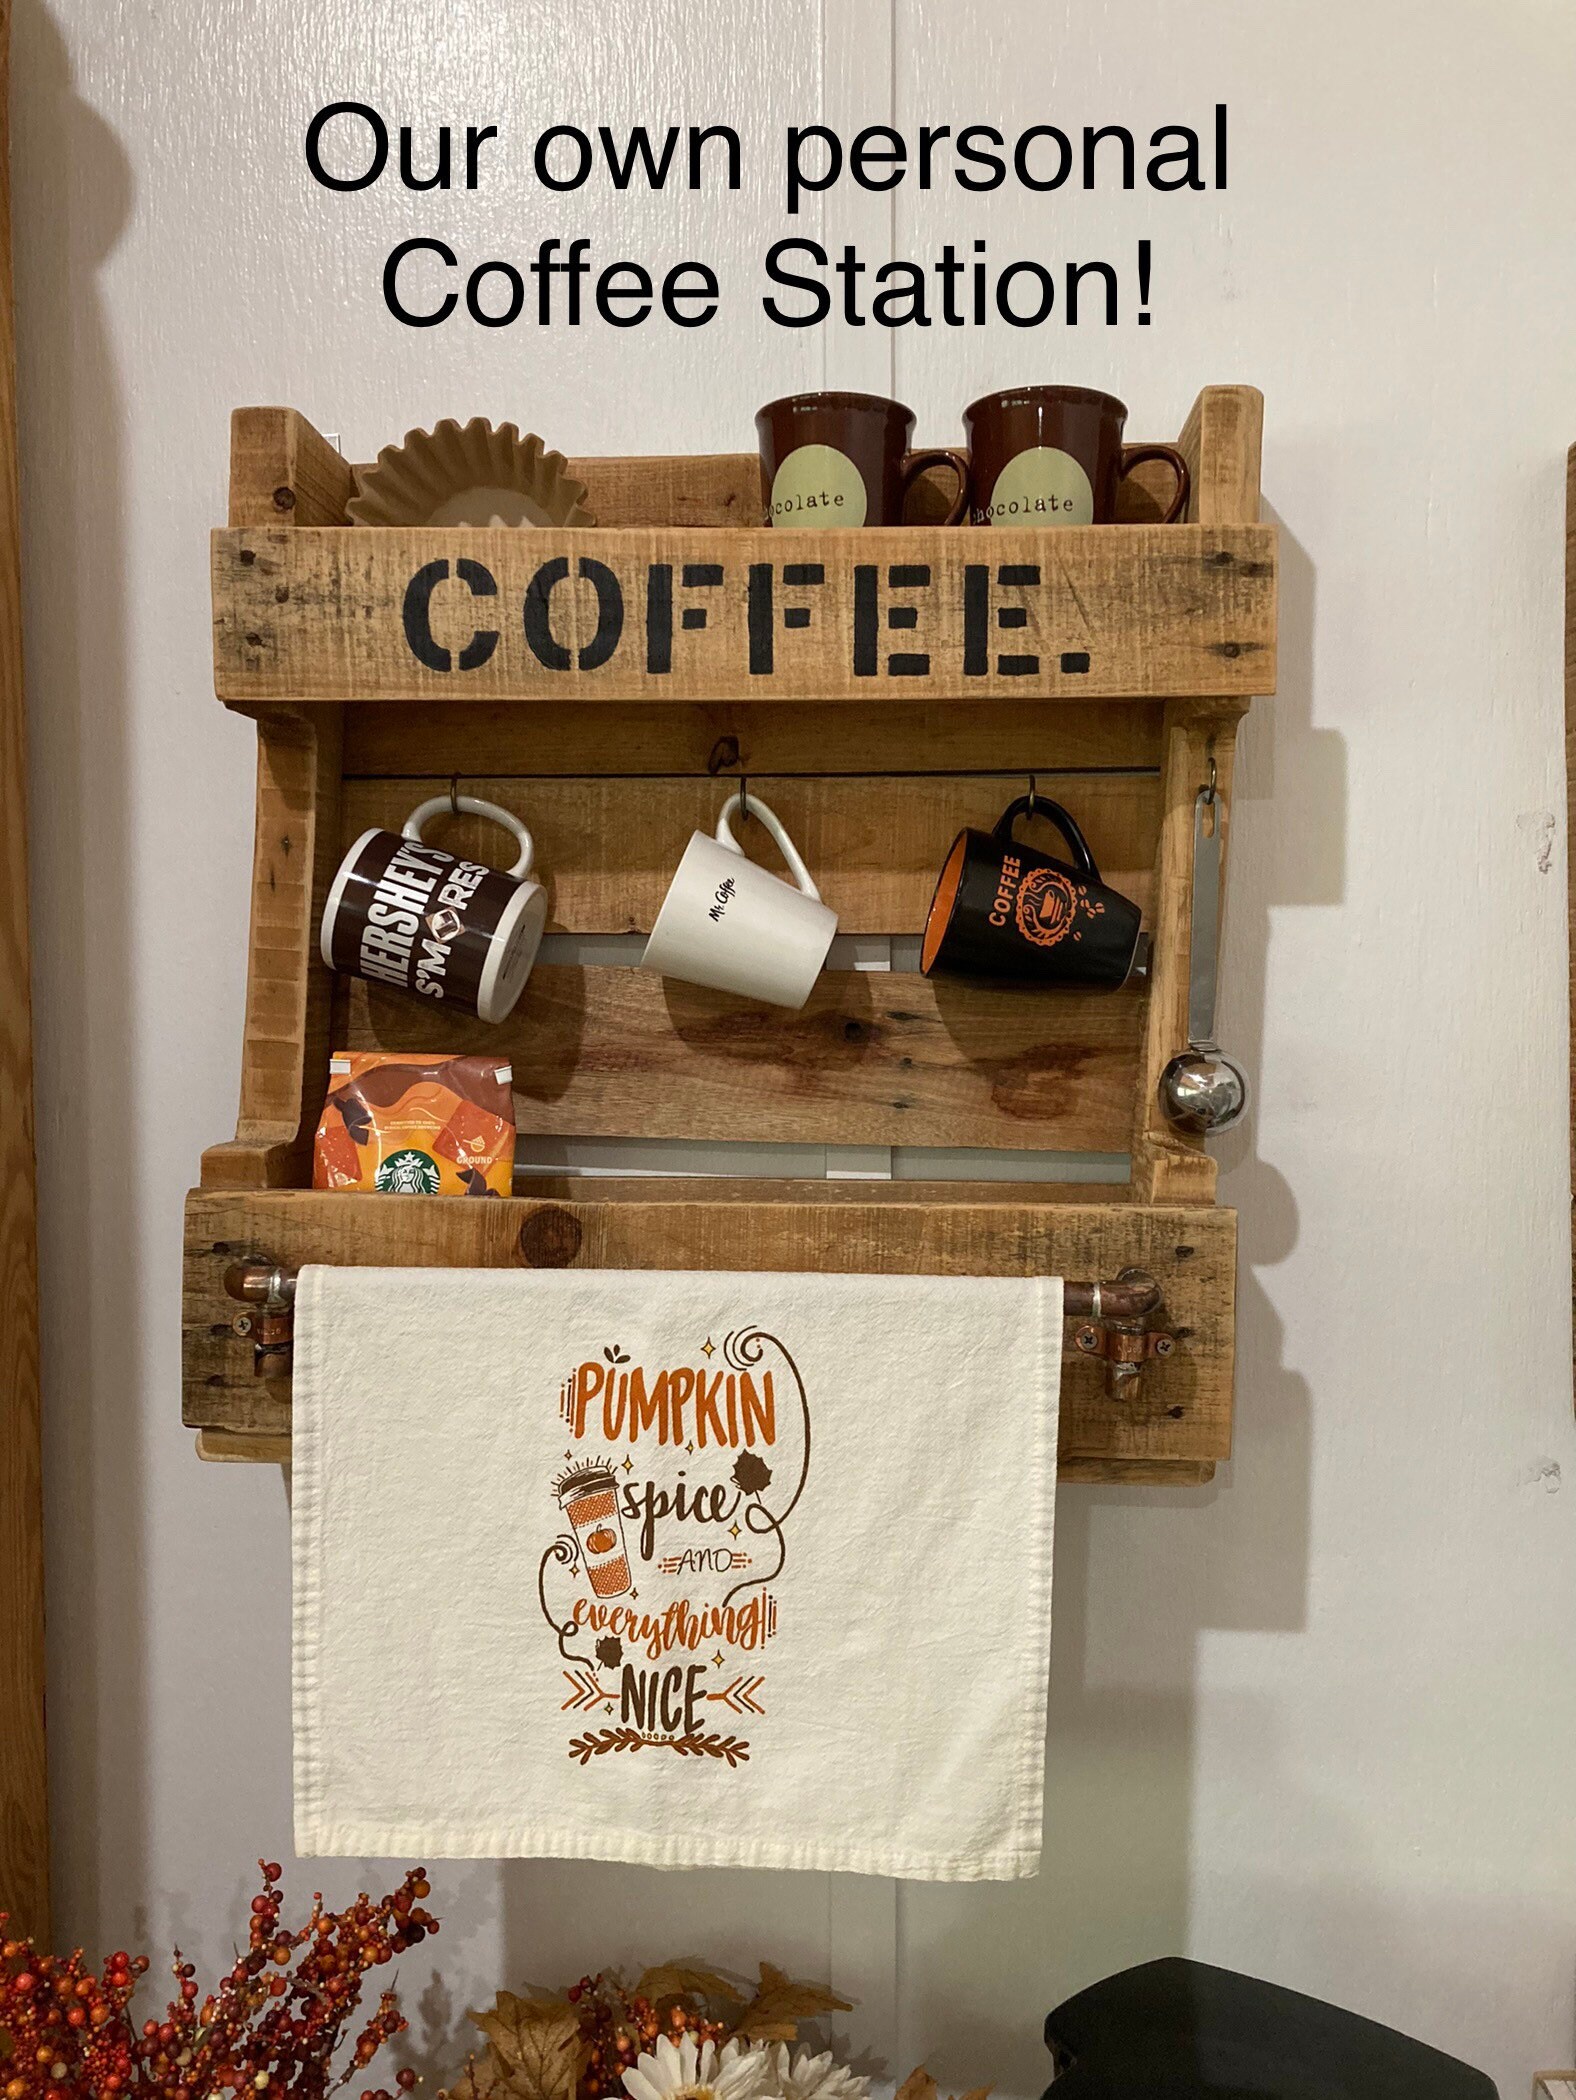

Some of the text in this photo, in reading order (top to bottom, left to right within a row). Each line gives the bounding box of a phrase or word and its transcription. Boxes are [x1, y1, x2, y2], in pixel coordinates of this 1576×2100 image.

[402, 557, 1091, 677] COFFEE.
[360, 841, 455, 988] HERSHEY'S
[988, 854, 1021, 927] COFFEE
[456, 1154, 493, 1165] GROUND
[574, 1361, 776, 1449] PUMPKIN
[620, 1470, 742, 1561] spice
[676, 1548, 734, 1576] AND
[572, 1598, 764, 1661] everything
[620, 1663, 708, 1735] NICE
